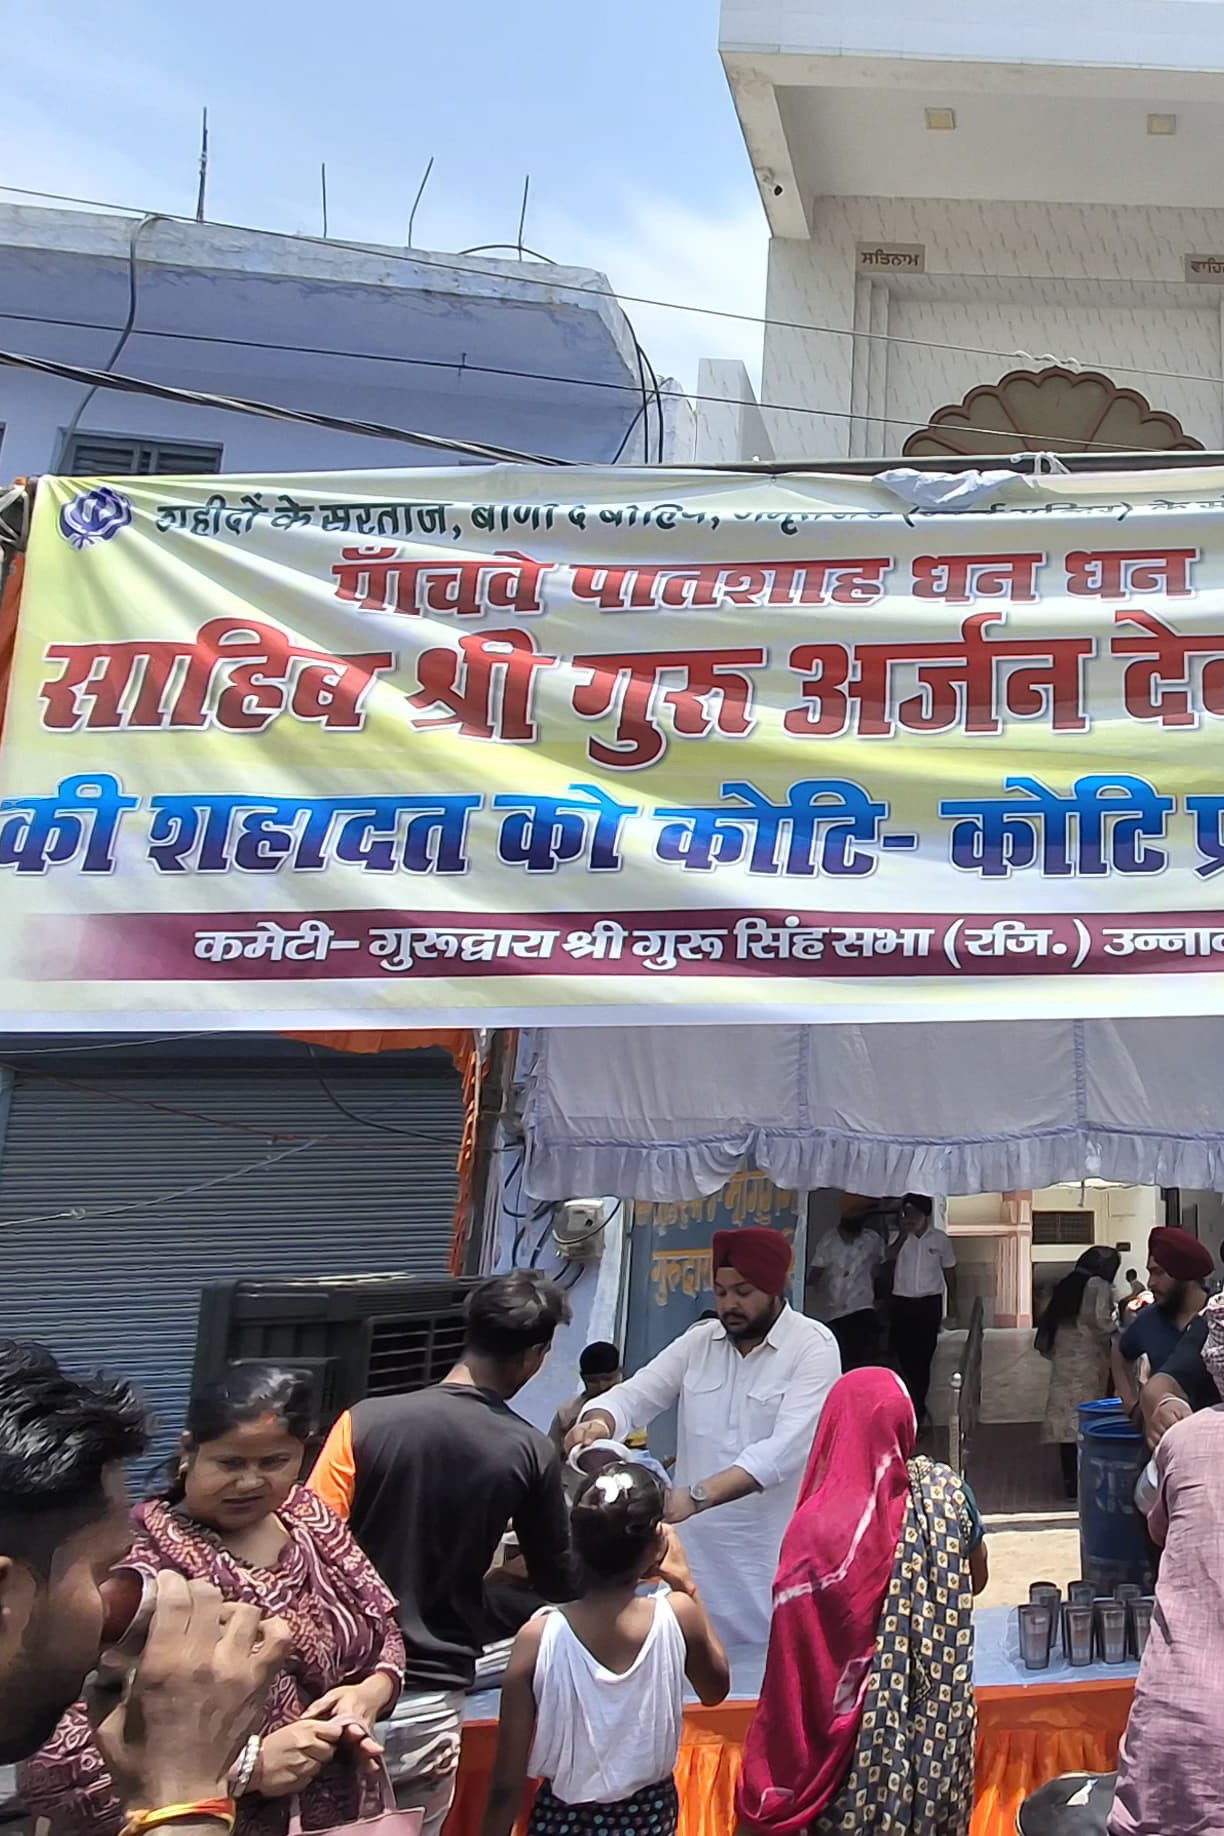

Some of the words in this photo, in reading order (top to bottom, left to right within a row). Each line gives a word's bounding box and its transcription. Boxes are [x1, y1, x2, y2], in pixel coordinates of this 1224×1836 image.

[861, 250, 920, 268] ਸਤਿਨਾਮ
[270, 494, 315, 530] के
[319, 502, 463, 540] सरताज,
[569, 557, 891, 609] पातशाह
[911, 551, 1044, 603] धन
[1063, 547, 1201, 599] धन
[38, 617, 395, 733] साहिब
[405, 628, 557, 743] श्री
[783, 612, 1095, 739] अर्जन
[0, 772, 138, 875] की
[146, 794, 488, 876] शहादत
[493, 782, 642, 873] को
[938, 773, 1179, 879] कोटि
[565, 919, 628, 961] श्री
[733, 915, 830, 960] सिंह
[831, 926, 936, 958] सभा
